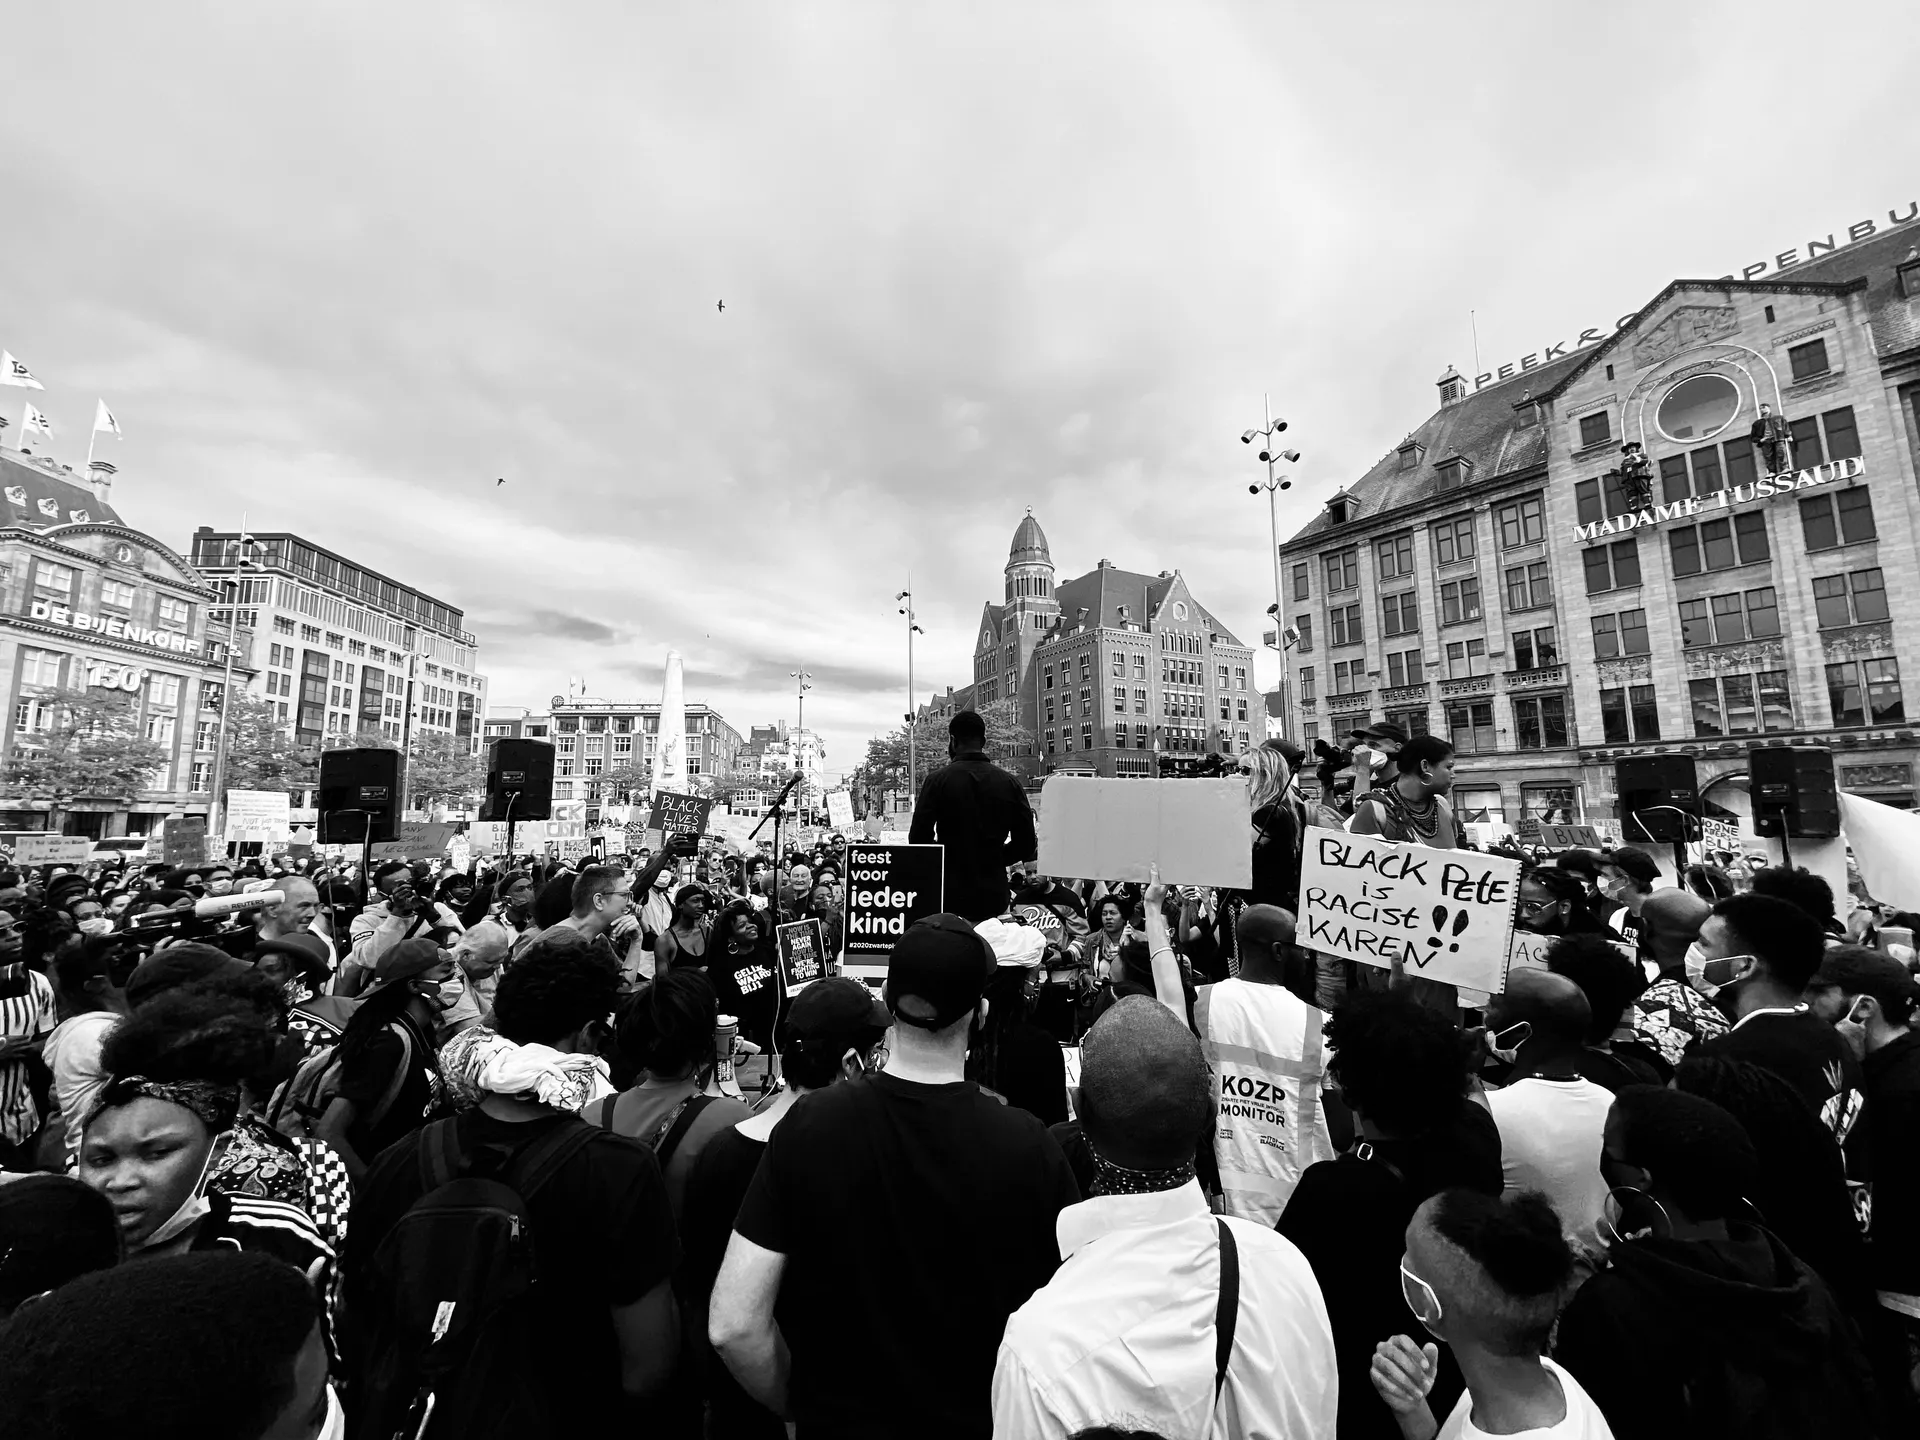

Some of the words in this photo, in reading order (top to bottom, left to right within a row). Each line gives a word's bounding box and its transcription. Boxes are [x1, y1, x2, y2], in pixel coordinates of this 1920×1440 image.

[1474, 340, 1567, 389] PEEK
[1577, 328, 1608, 348] &
[1573, 493, 1704, 542] MADAME
[31, 600, 70, 627] DE
[72, 612, 201, 653] BIJENKORF
[660, 795, 703, 815] BLACK
[663, 811, 700, 825] LIVES
[491, 823, 524, 832] BLK
[662, 821, 699, 834] MATTER
[399, 835, 427, 843] EANS
[1553, 827, 1595, 846] BLM
[491, 842, 525, 850] MATER
[851, 850, 892, 864] feest
[1319, 838, 1428, 886] BLACK
[850, 870, 889, 881] voor
[851, 885, 918, 908] ieder
[231, 899, 265, 909] REUTERS
[850, 911, 905, 935] kind
[1022, 906, 1061, 930] Patta
[785, 932, 799, 940] THE
[800, 928, 814, 937] TIME
[788, 925, 803, 934] NOW
[790, 935, 811, 945] NEVER
[792, 942, 812, 951] AGAIN
[1308, 914, 1438, 969] KAREN
[789, 954, 802, 963] THE
[802, 951, 818, 960] TIME
[791, 948, 807, 957] NOW
[790, 962, 820, 975] FIGHTING
[794, 957, 814, 968] WE'RE
[795, 972, 805, 980] TO
[805, 969, 818, 977] WIN
[740, 980, 763, 995] BIJ1
[1222, 1074, 1286, 1104] KOZP
[1220, 1103, 1285, 1128] MONITOR
